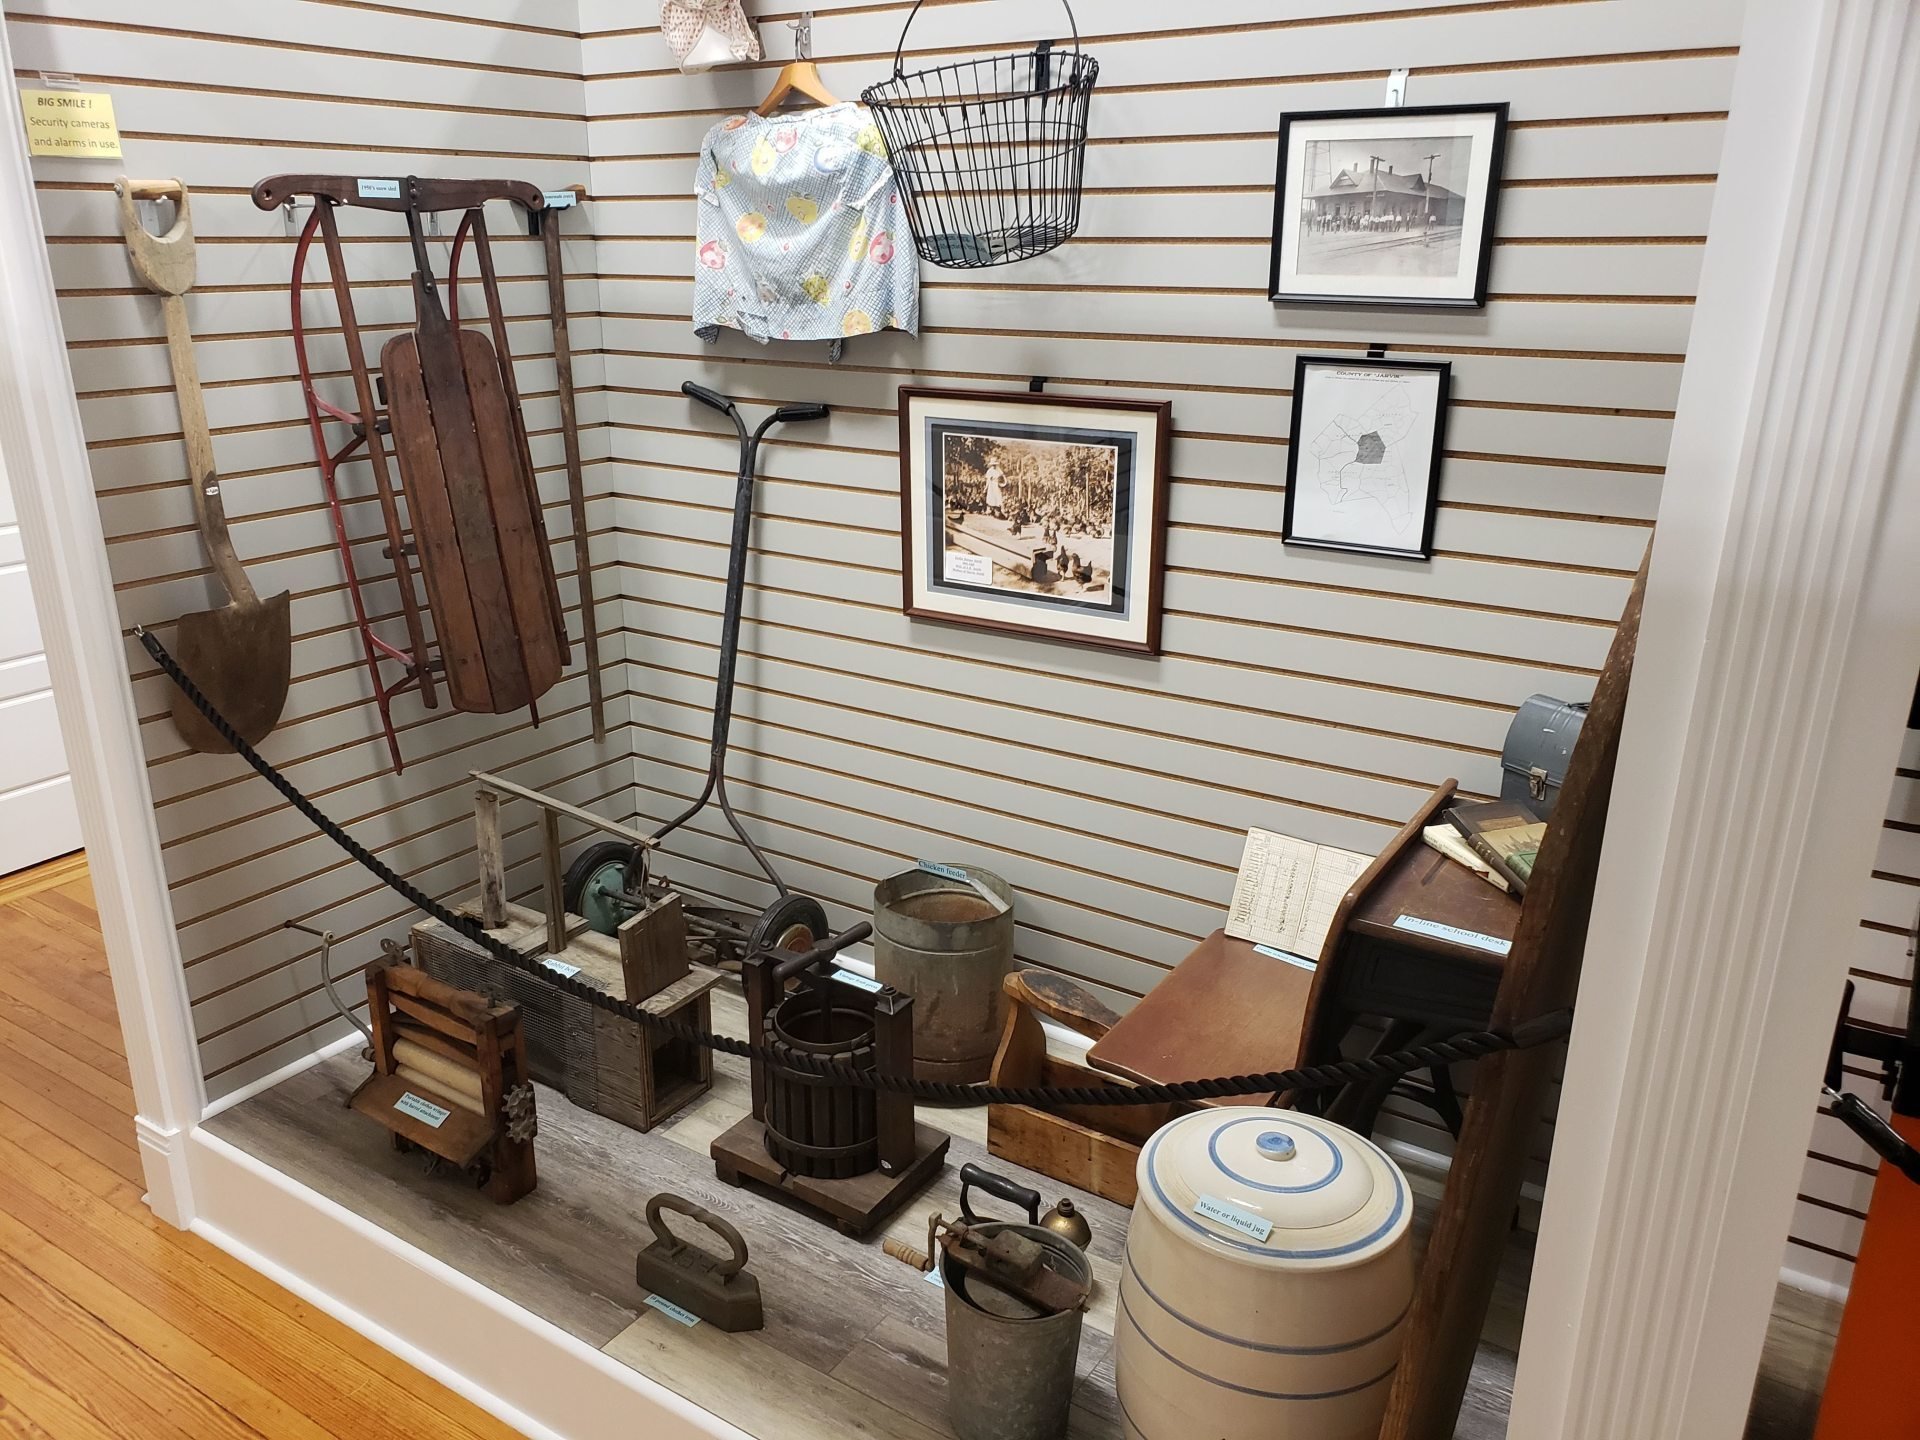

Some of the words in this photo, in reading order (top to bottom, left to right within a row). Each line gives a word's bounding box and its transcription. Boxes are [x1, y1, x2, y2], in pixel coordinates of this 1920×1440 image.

[37, 97, 54, 107] BIG
[57, 98, 86, 108] SMILE
[30, 116, 68, 128] Security
[71, 120, 110, 129] cameras
[34, 137, 52, 146] and
[55, 138, 86, 147] alarms
[88, 139, 98, 148] in
[99, 141, 119, 149] use.
[918, 861, 945, 873] Chicken
[946, 867, 966, 879] feeder
[1403, 916, 1439, 928] In-line
[1441, 928, 1479, 939] school
[1480, 936, 1507, 947] desk
[546, 960, 565, 970] Rabbit
[1200, 1201, 1222, 1215] Water
[1221, 1211, 1231, 1219] or
[1230, 1214, 1252, 1230] liquid
[1251, 1224, 1265, 1236] jug
[655, 1299, 670, 1309] pound
[669, 1307, 685, 1317] clothes
[684, 1314, 695, 1323] iron
